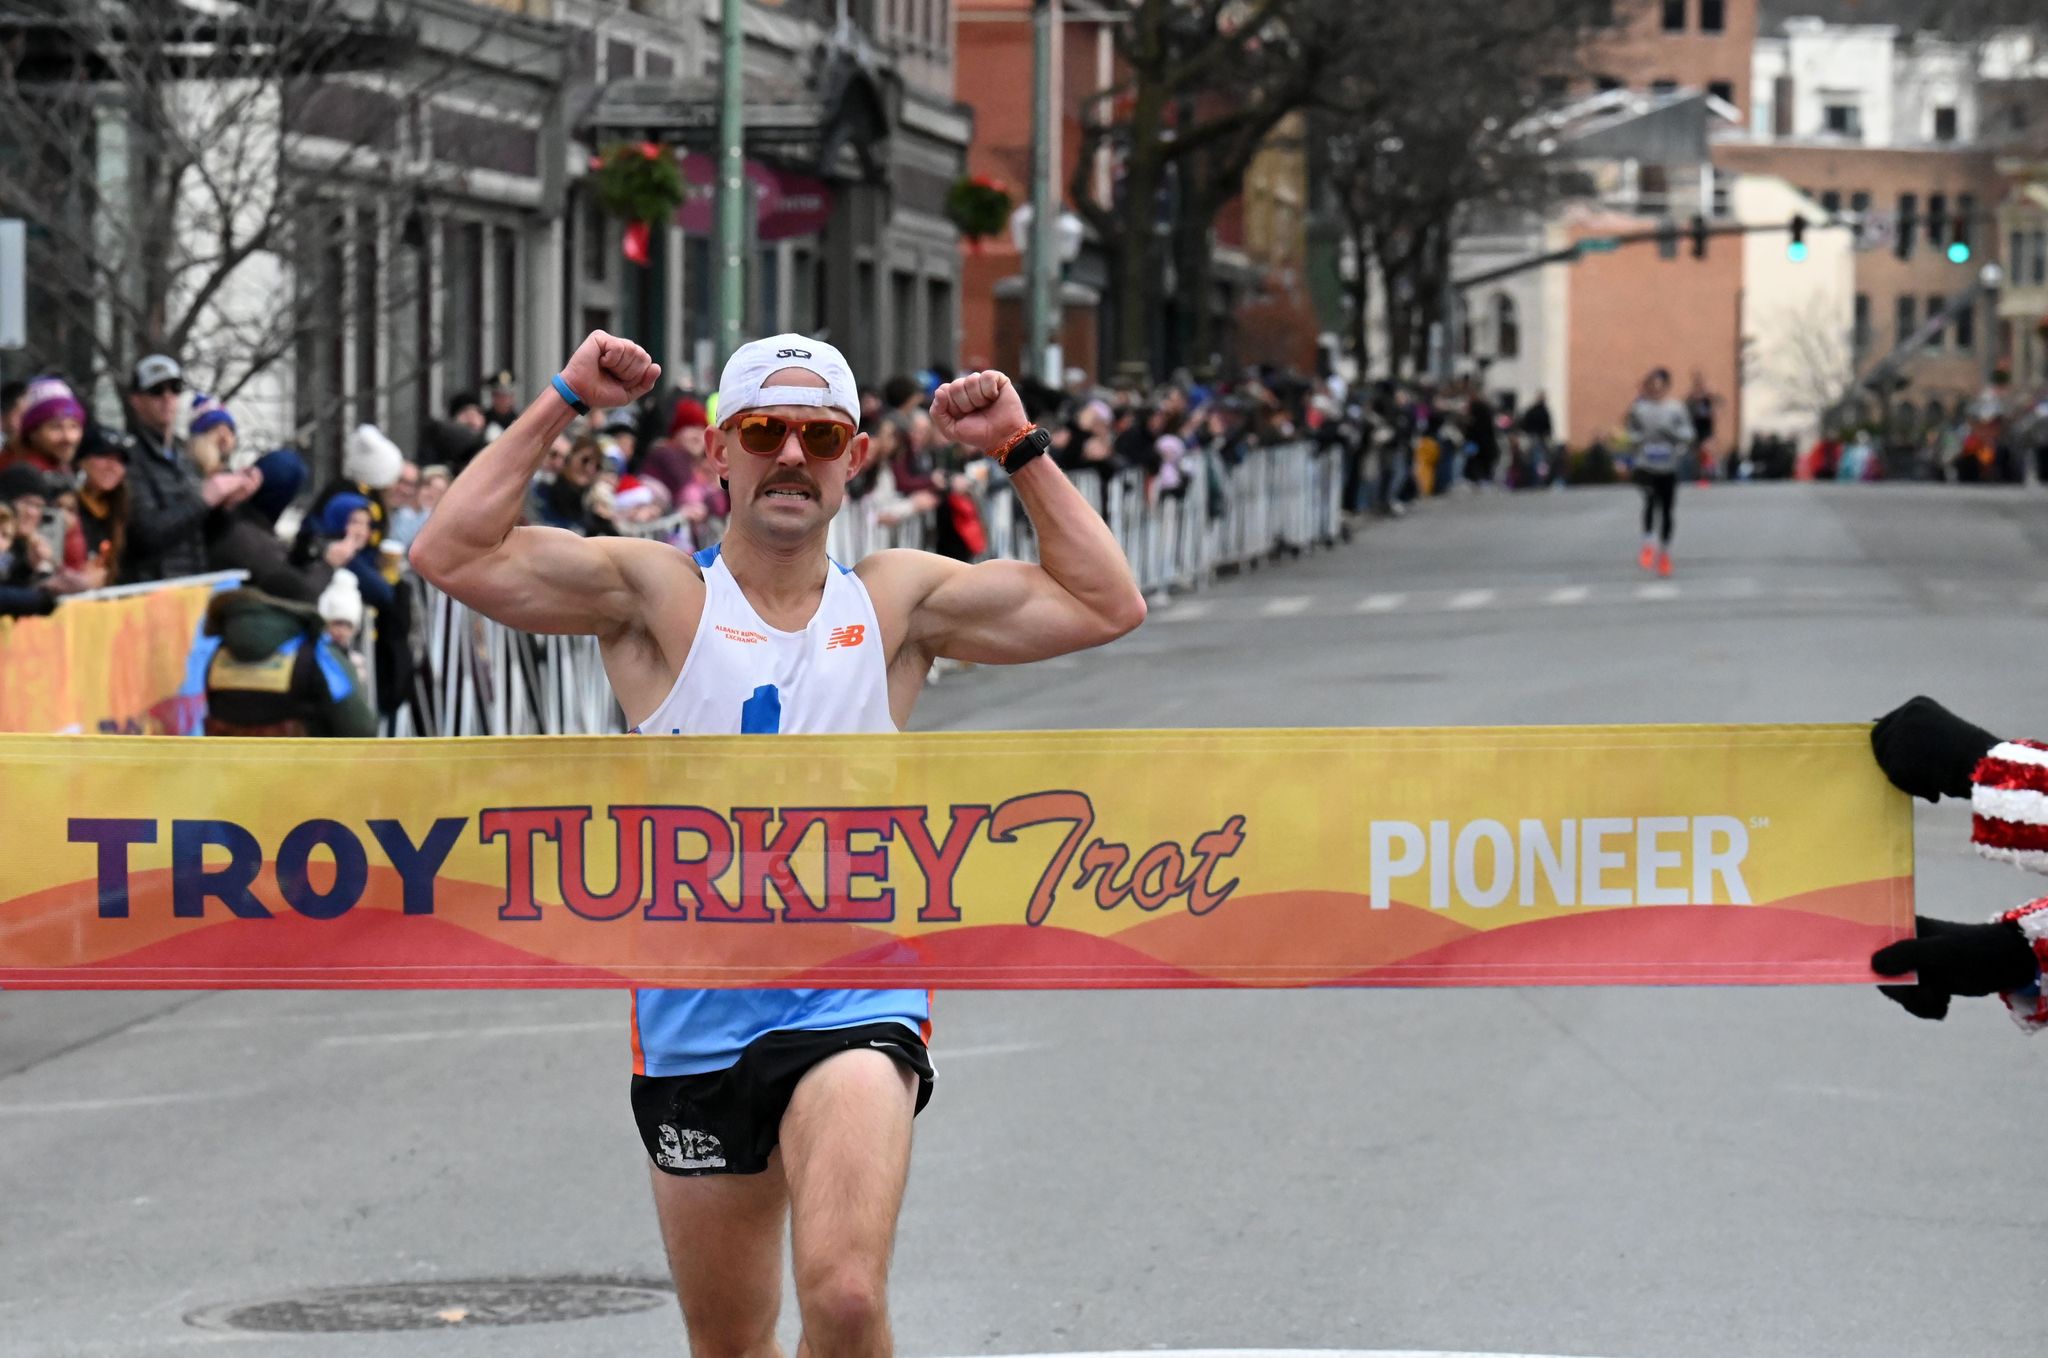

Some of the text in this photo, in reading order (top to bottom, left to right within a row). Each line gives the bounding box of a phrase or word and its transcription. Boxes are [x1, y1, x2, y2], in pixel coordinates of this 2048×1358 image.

[714, 624, 769, 643] ALBANY RUNNING
[725, 633, 758, 645] EXCHANGE
[67, 789, 1246, 926] TROY TURKEY Trot
[1369, 815, 1753, 909] PIONEER
